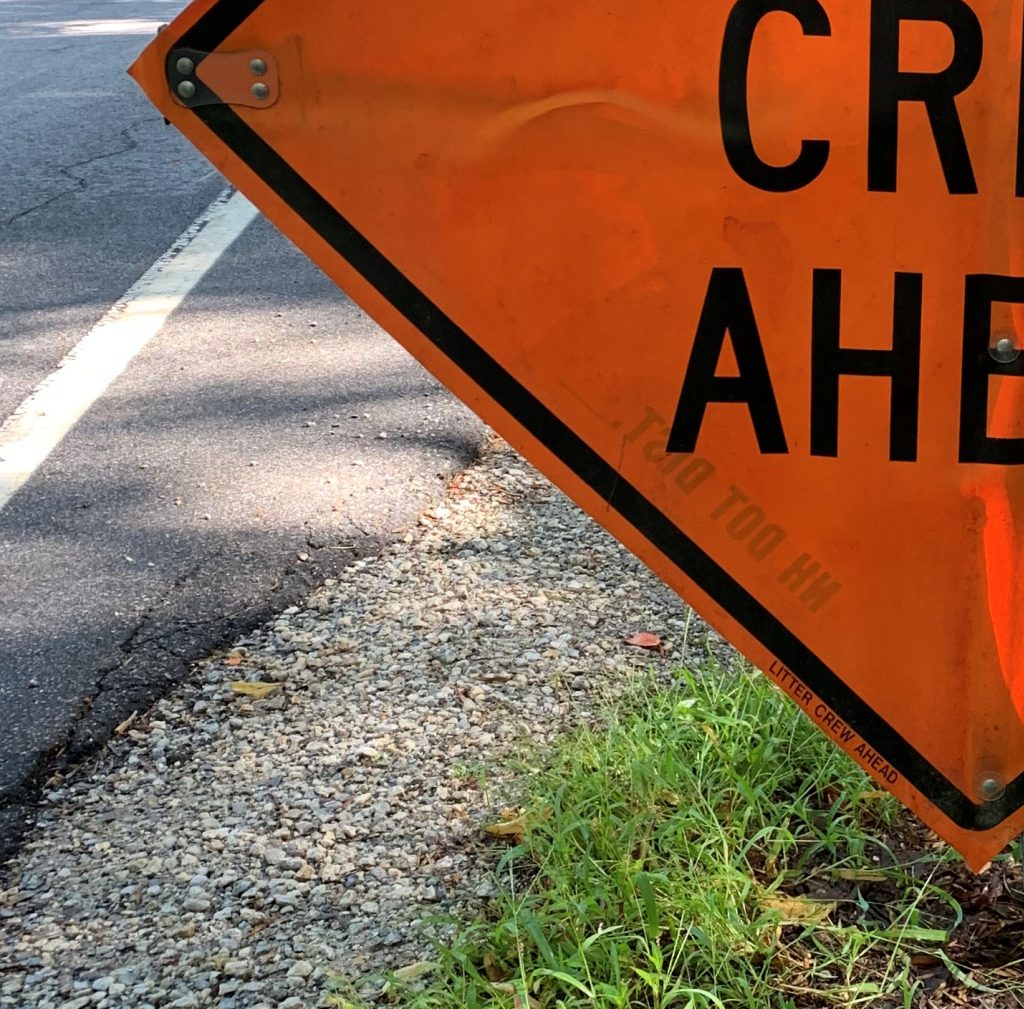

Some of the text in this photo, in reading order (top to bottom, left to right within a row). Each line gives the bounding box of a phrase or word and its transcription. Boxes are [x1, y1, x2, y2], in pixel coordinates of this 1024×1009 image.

[768, 660, 899, 785] LITTER CREW AHEAD
